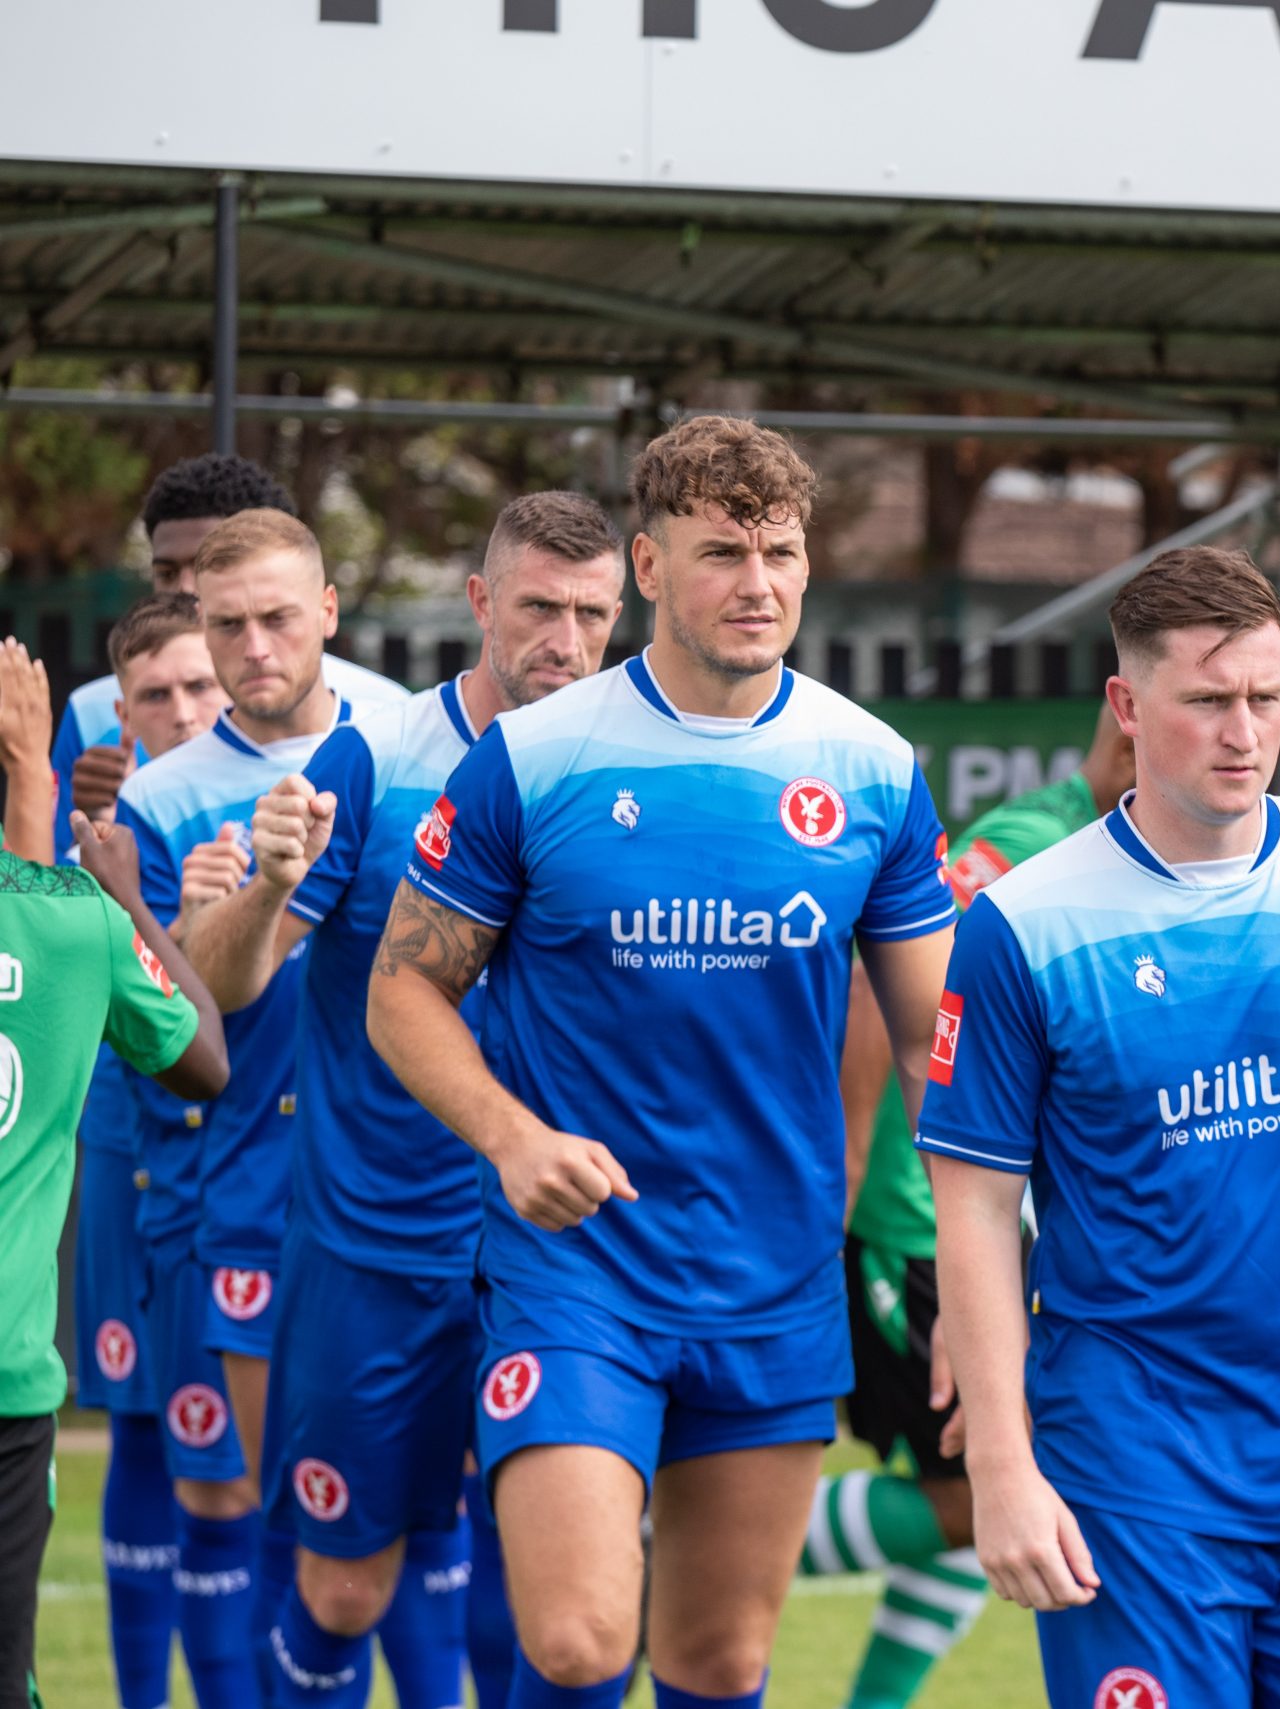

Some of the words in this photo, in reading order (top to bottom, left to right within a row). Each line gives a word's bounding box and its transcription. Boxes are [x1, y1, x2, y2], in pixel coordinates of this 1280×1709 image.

[611, 898, 773, 945] utilita
[612, 947, 643, 969] life
[650, 949, 696, 969] with
[701, 953, 770, 974] power
[1162, 1128, 1190, 1151] life
[1194, 1116, 1243, 1143] with
